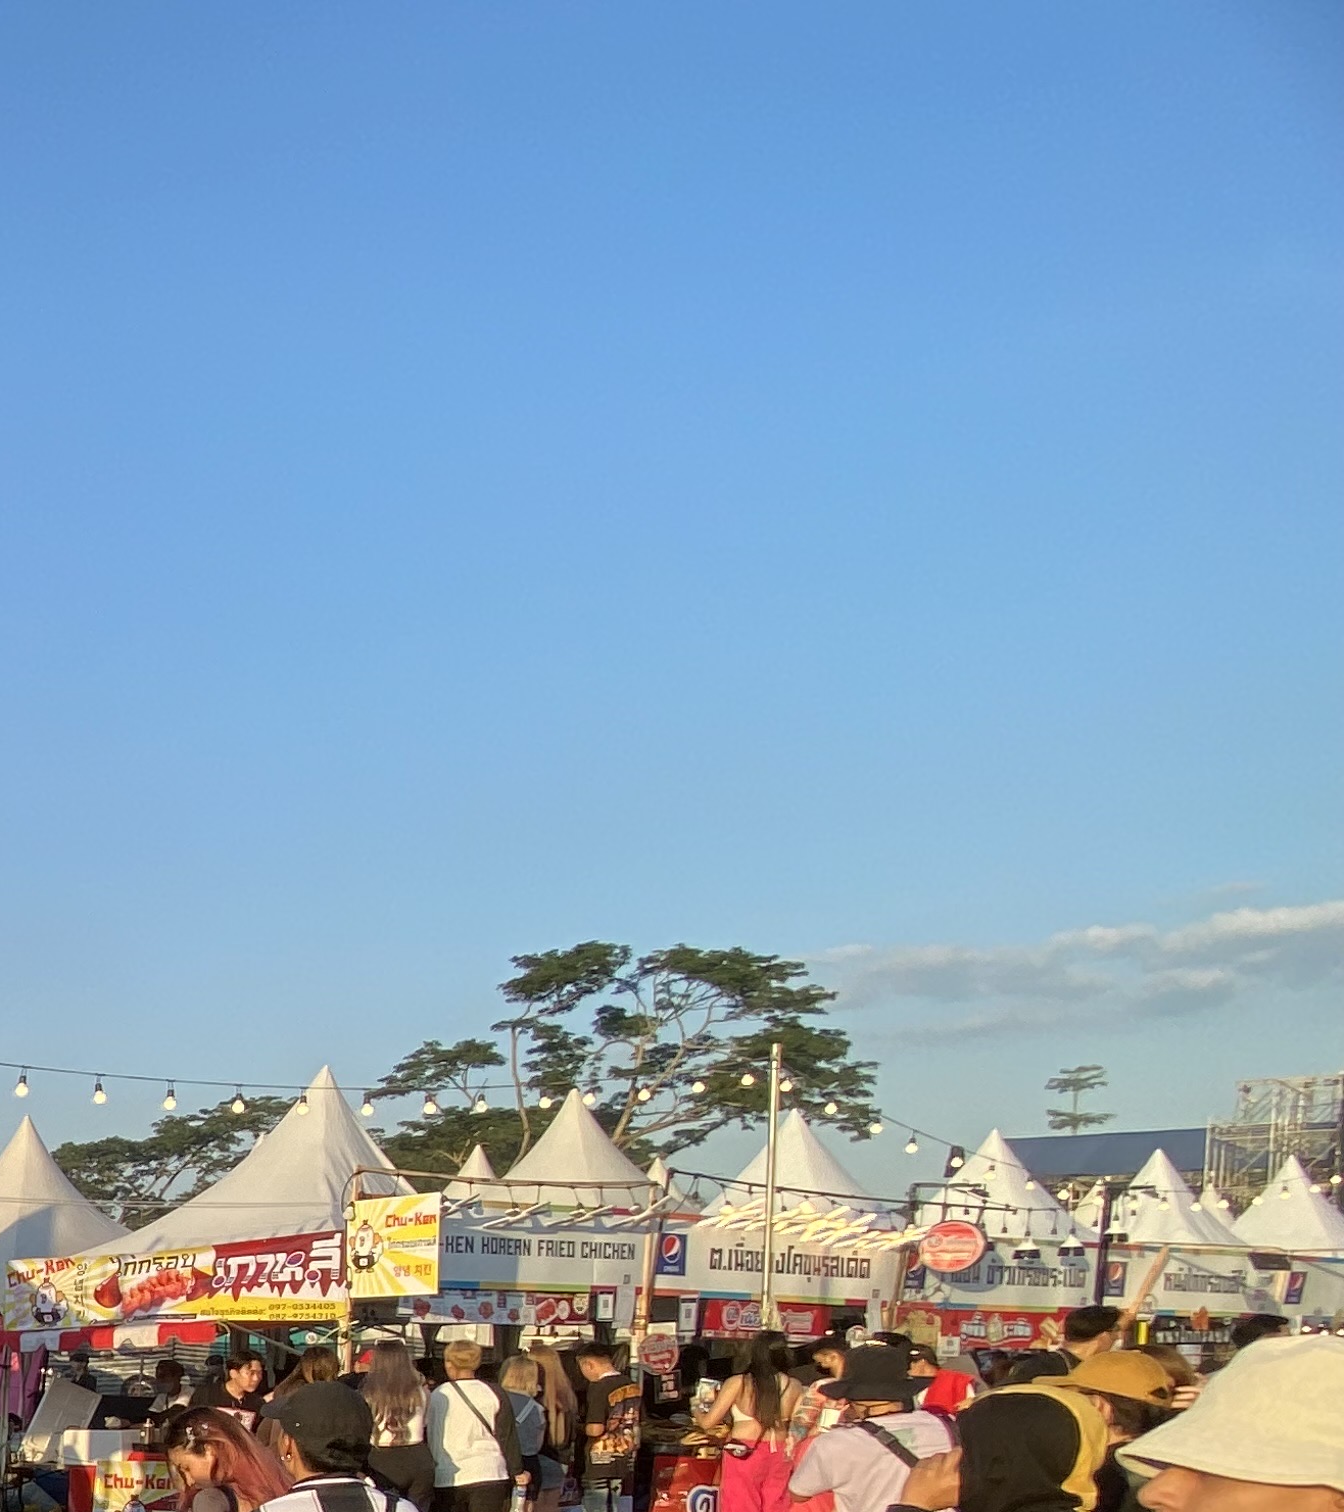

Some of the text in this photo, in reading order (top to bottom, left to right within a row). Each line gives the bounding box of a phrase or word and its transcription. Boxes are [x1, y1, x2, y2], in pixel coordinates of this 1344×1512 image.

[384, 1212, 437, 1228] Chu-Ken
[212, 1232, 343, 1288] เกาหลี
[481, 1238, 532, 1257] KOREAN
[537, 1239, 576, 1258] FRIED
[580, 1241, 636, 1260] CHICKEN
